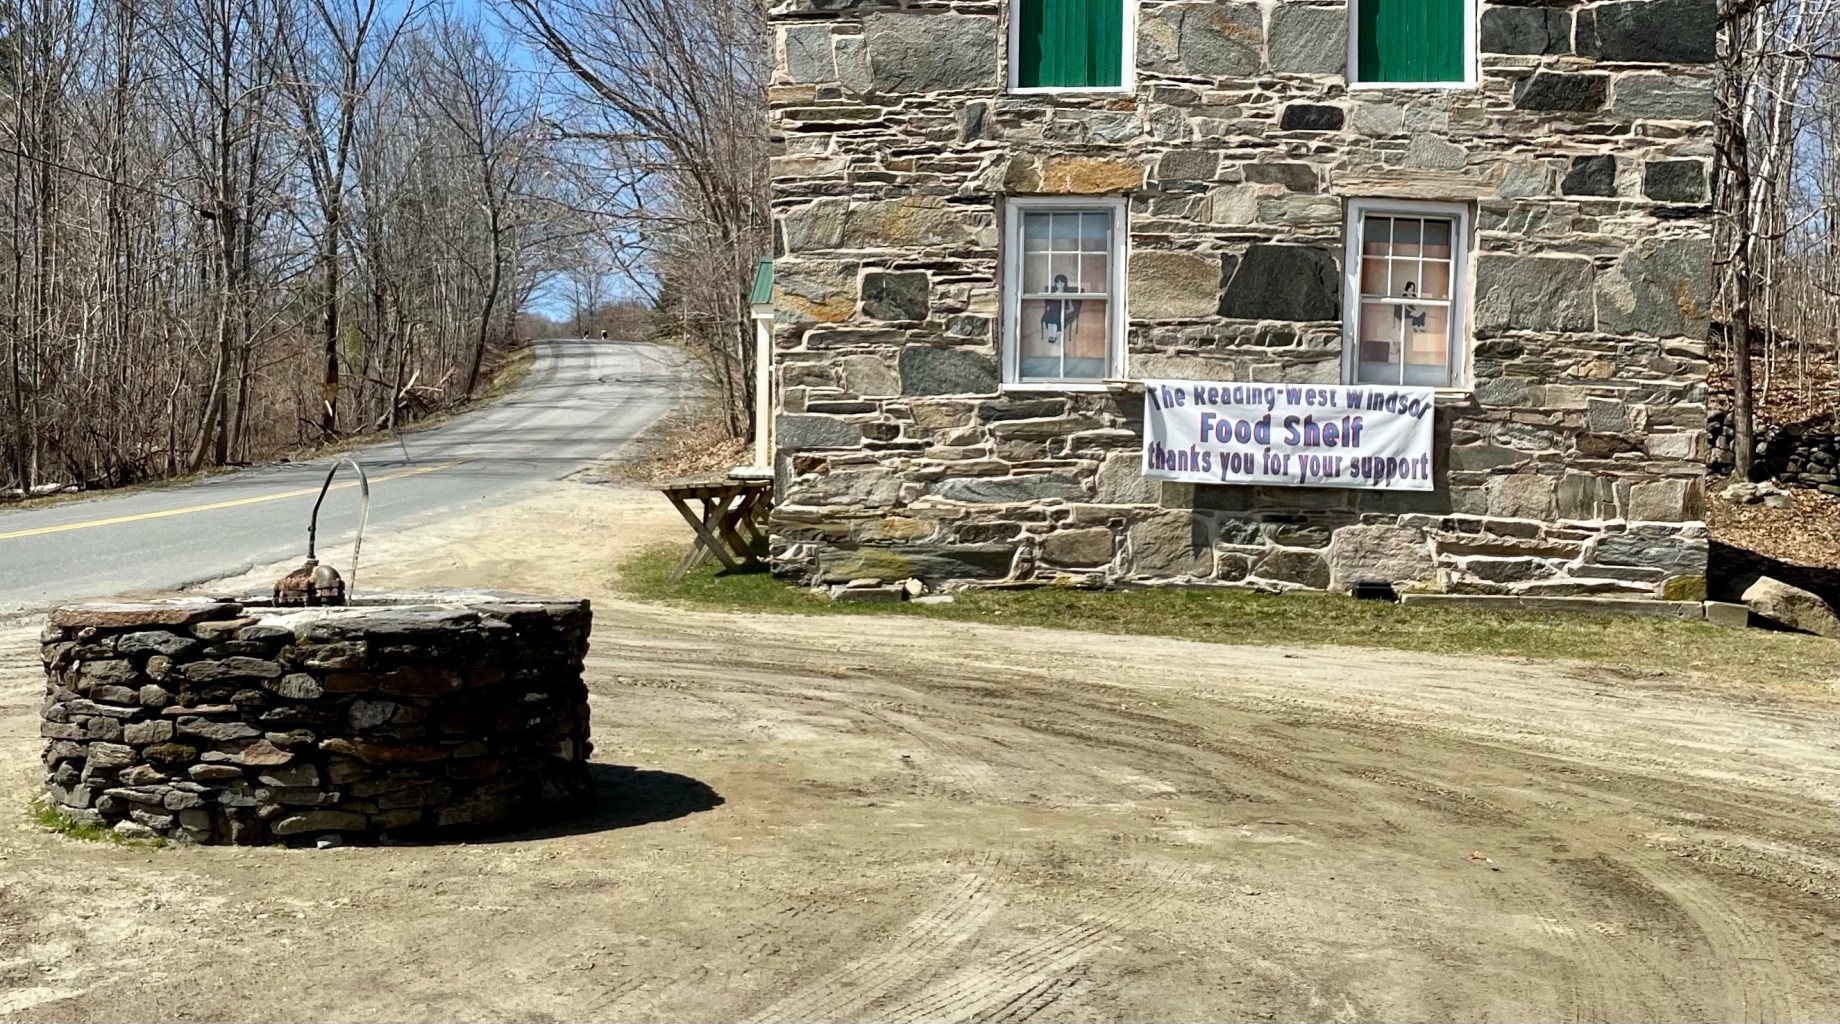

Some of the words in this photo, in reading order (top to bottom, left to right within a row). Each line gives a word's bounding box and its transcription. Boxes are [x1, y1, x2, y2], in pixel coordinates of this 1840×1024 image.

[1147, 384, 1186, 411] The
[1346, 388, 1432, 420] Windsor
[1200, 412, 1271, 444] Food
[1283, 414, 1363, 448] Shelf
[1148, 441, 1211, 472] thanks
[1220, 451, 1255, 481] you
[1263, 446, 1290, 476] for
[1298, 454, 1342, 484] your
[1350, 452, 1429, 487] support
